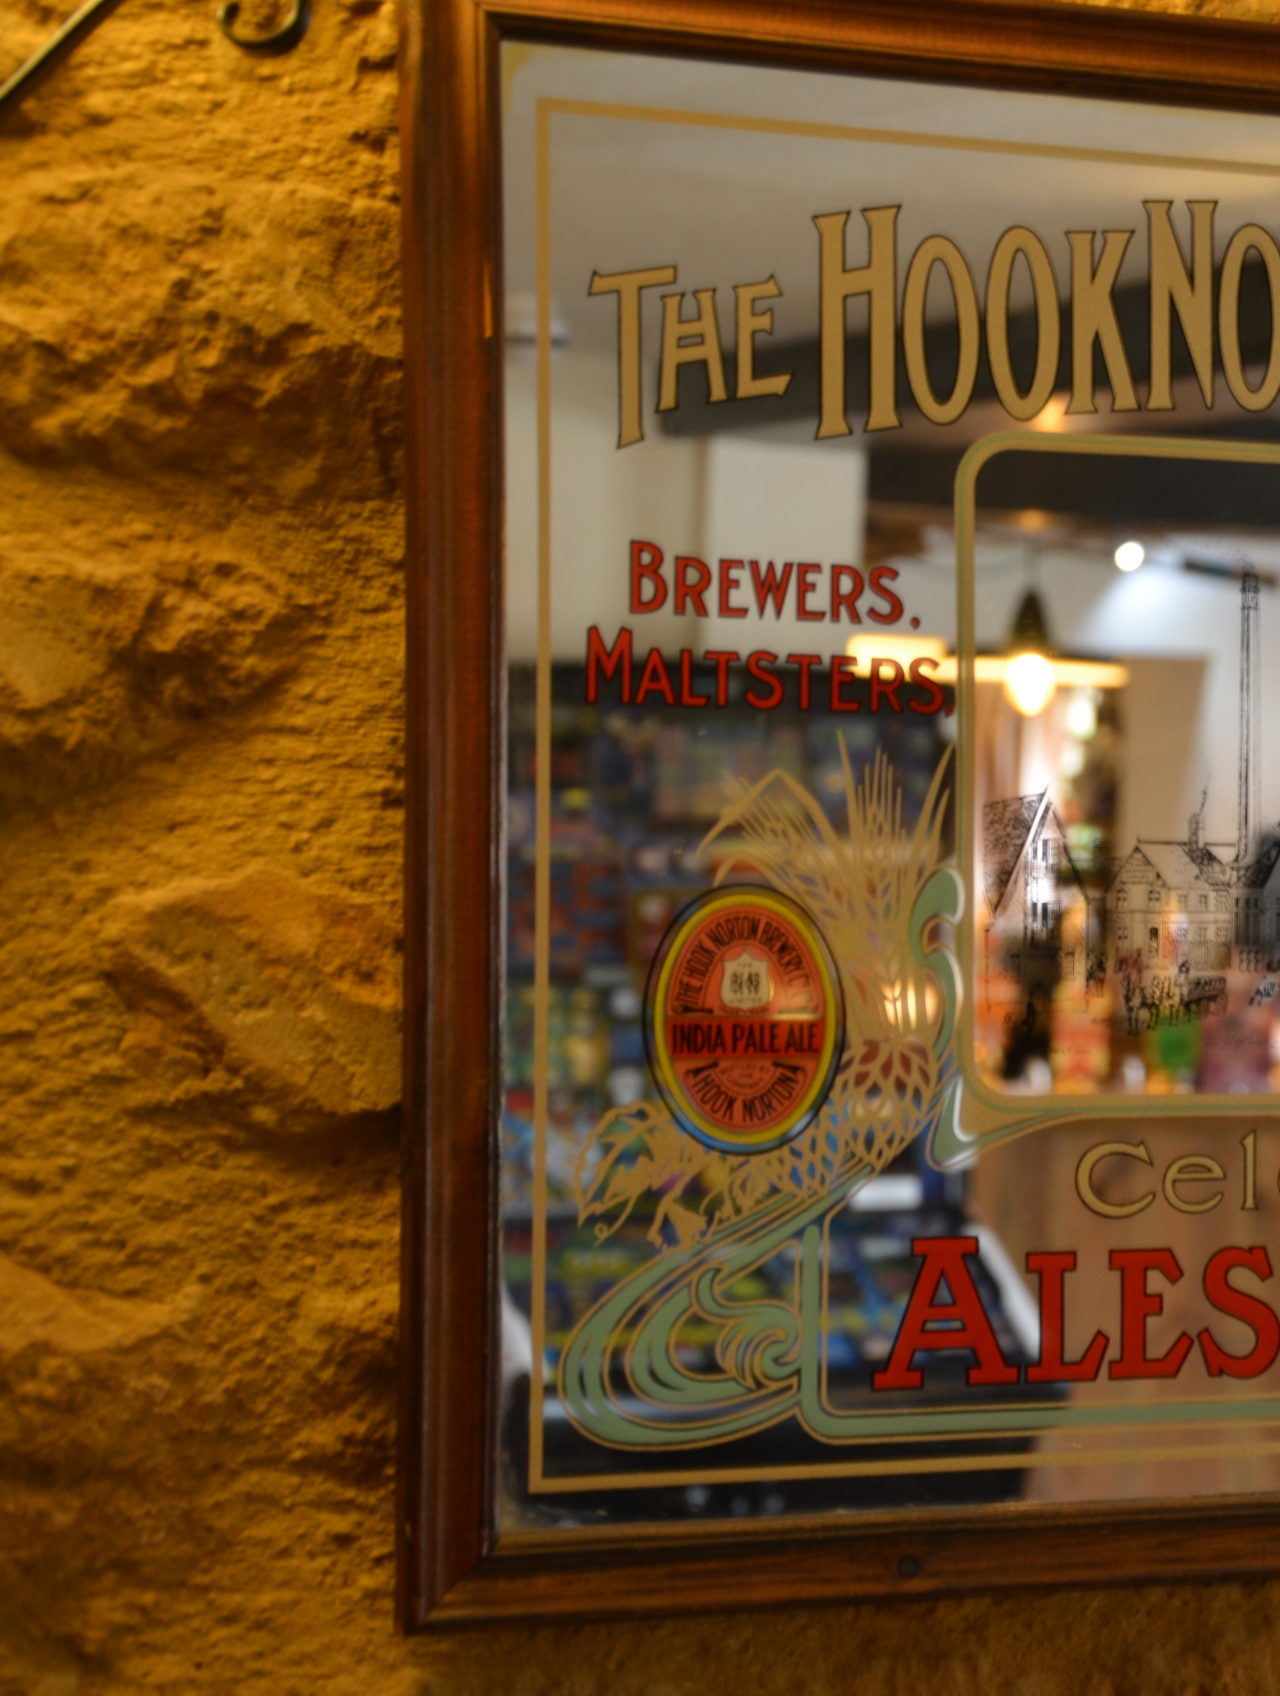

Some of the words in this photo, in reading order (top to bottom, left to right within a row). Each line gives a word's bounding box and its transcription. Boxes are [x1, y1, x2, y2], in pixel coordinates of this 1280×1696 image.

[588, 265, 793, 449] THE
[672, 1023, 728, 1054] INDIA
[733, 1023, 779, 1054] PALE
[785, 1022, 820, 1053] ALE
[692, 1069, 736, 1122] HOOK
[741, 1072, 800, 1123] NORTON
